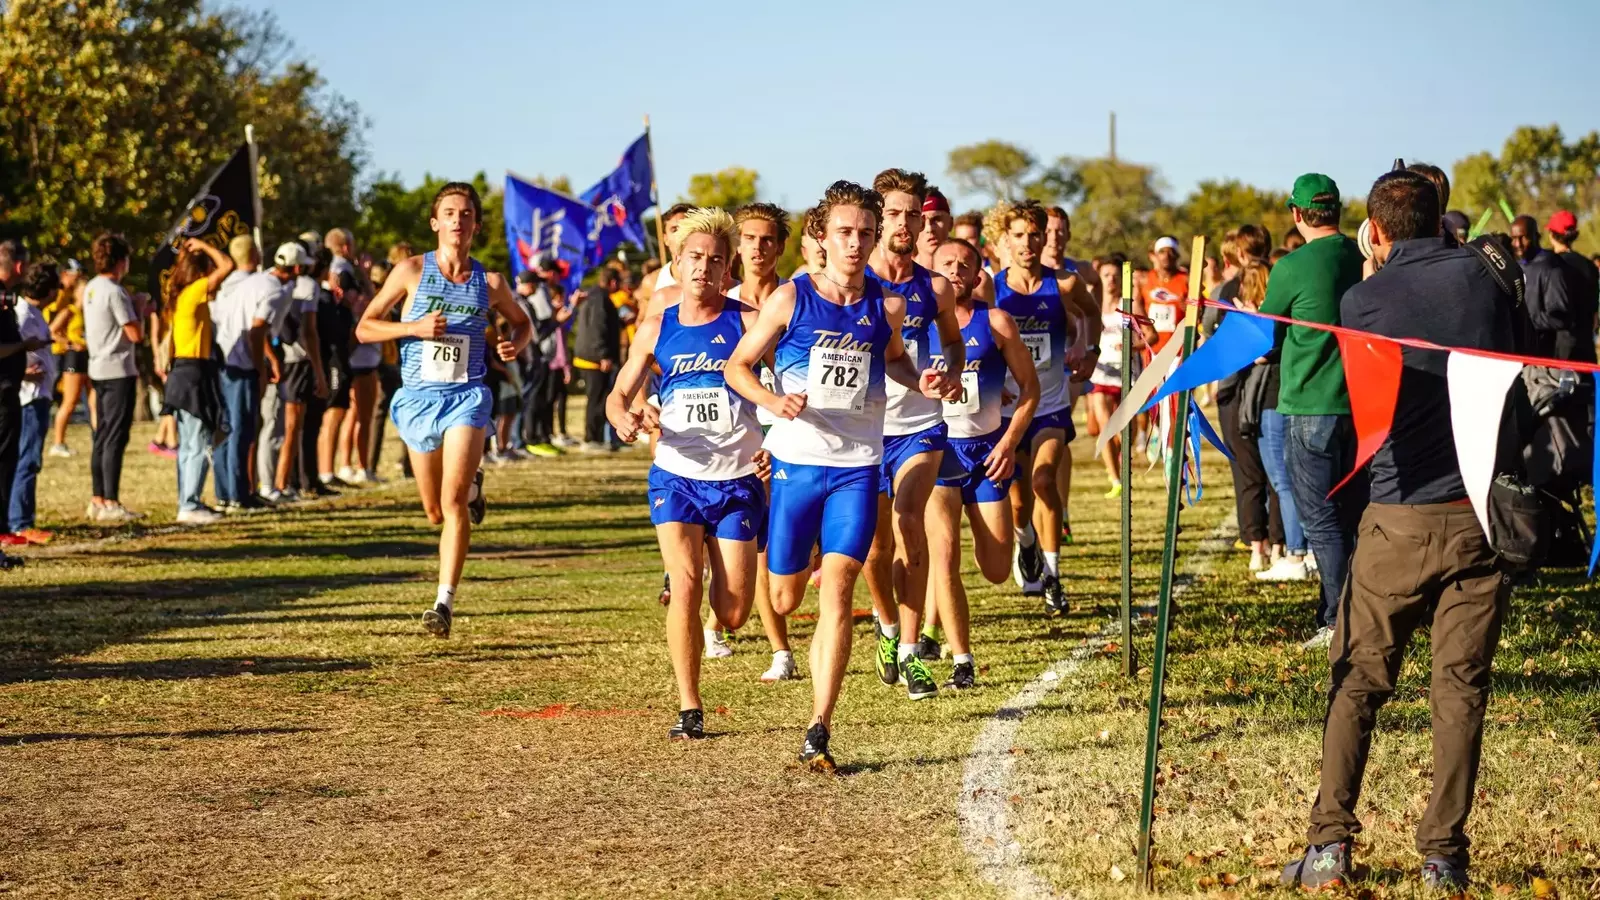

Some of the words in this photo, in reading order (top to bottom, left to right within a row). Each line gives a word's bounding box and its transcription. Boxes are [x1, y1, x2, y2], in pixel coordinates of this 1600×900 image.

[433, 345, 461, 363] 769
[669, 351, 728, 377] Tulsa
[820, 364, 859, 388] 782
[685, 403, 719, 423] 786
